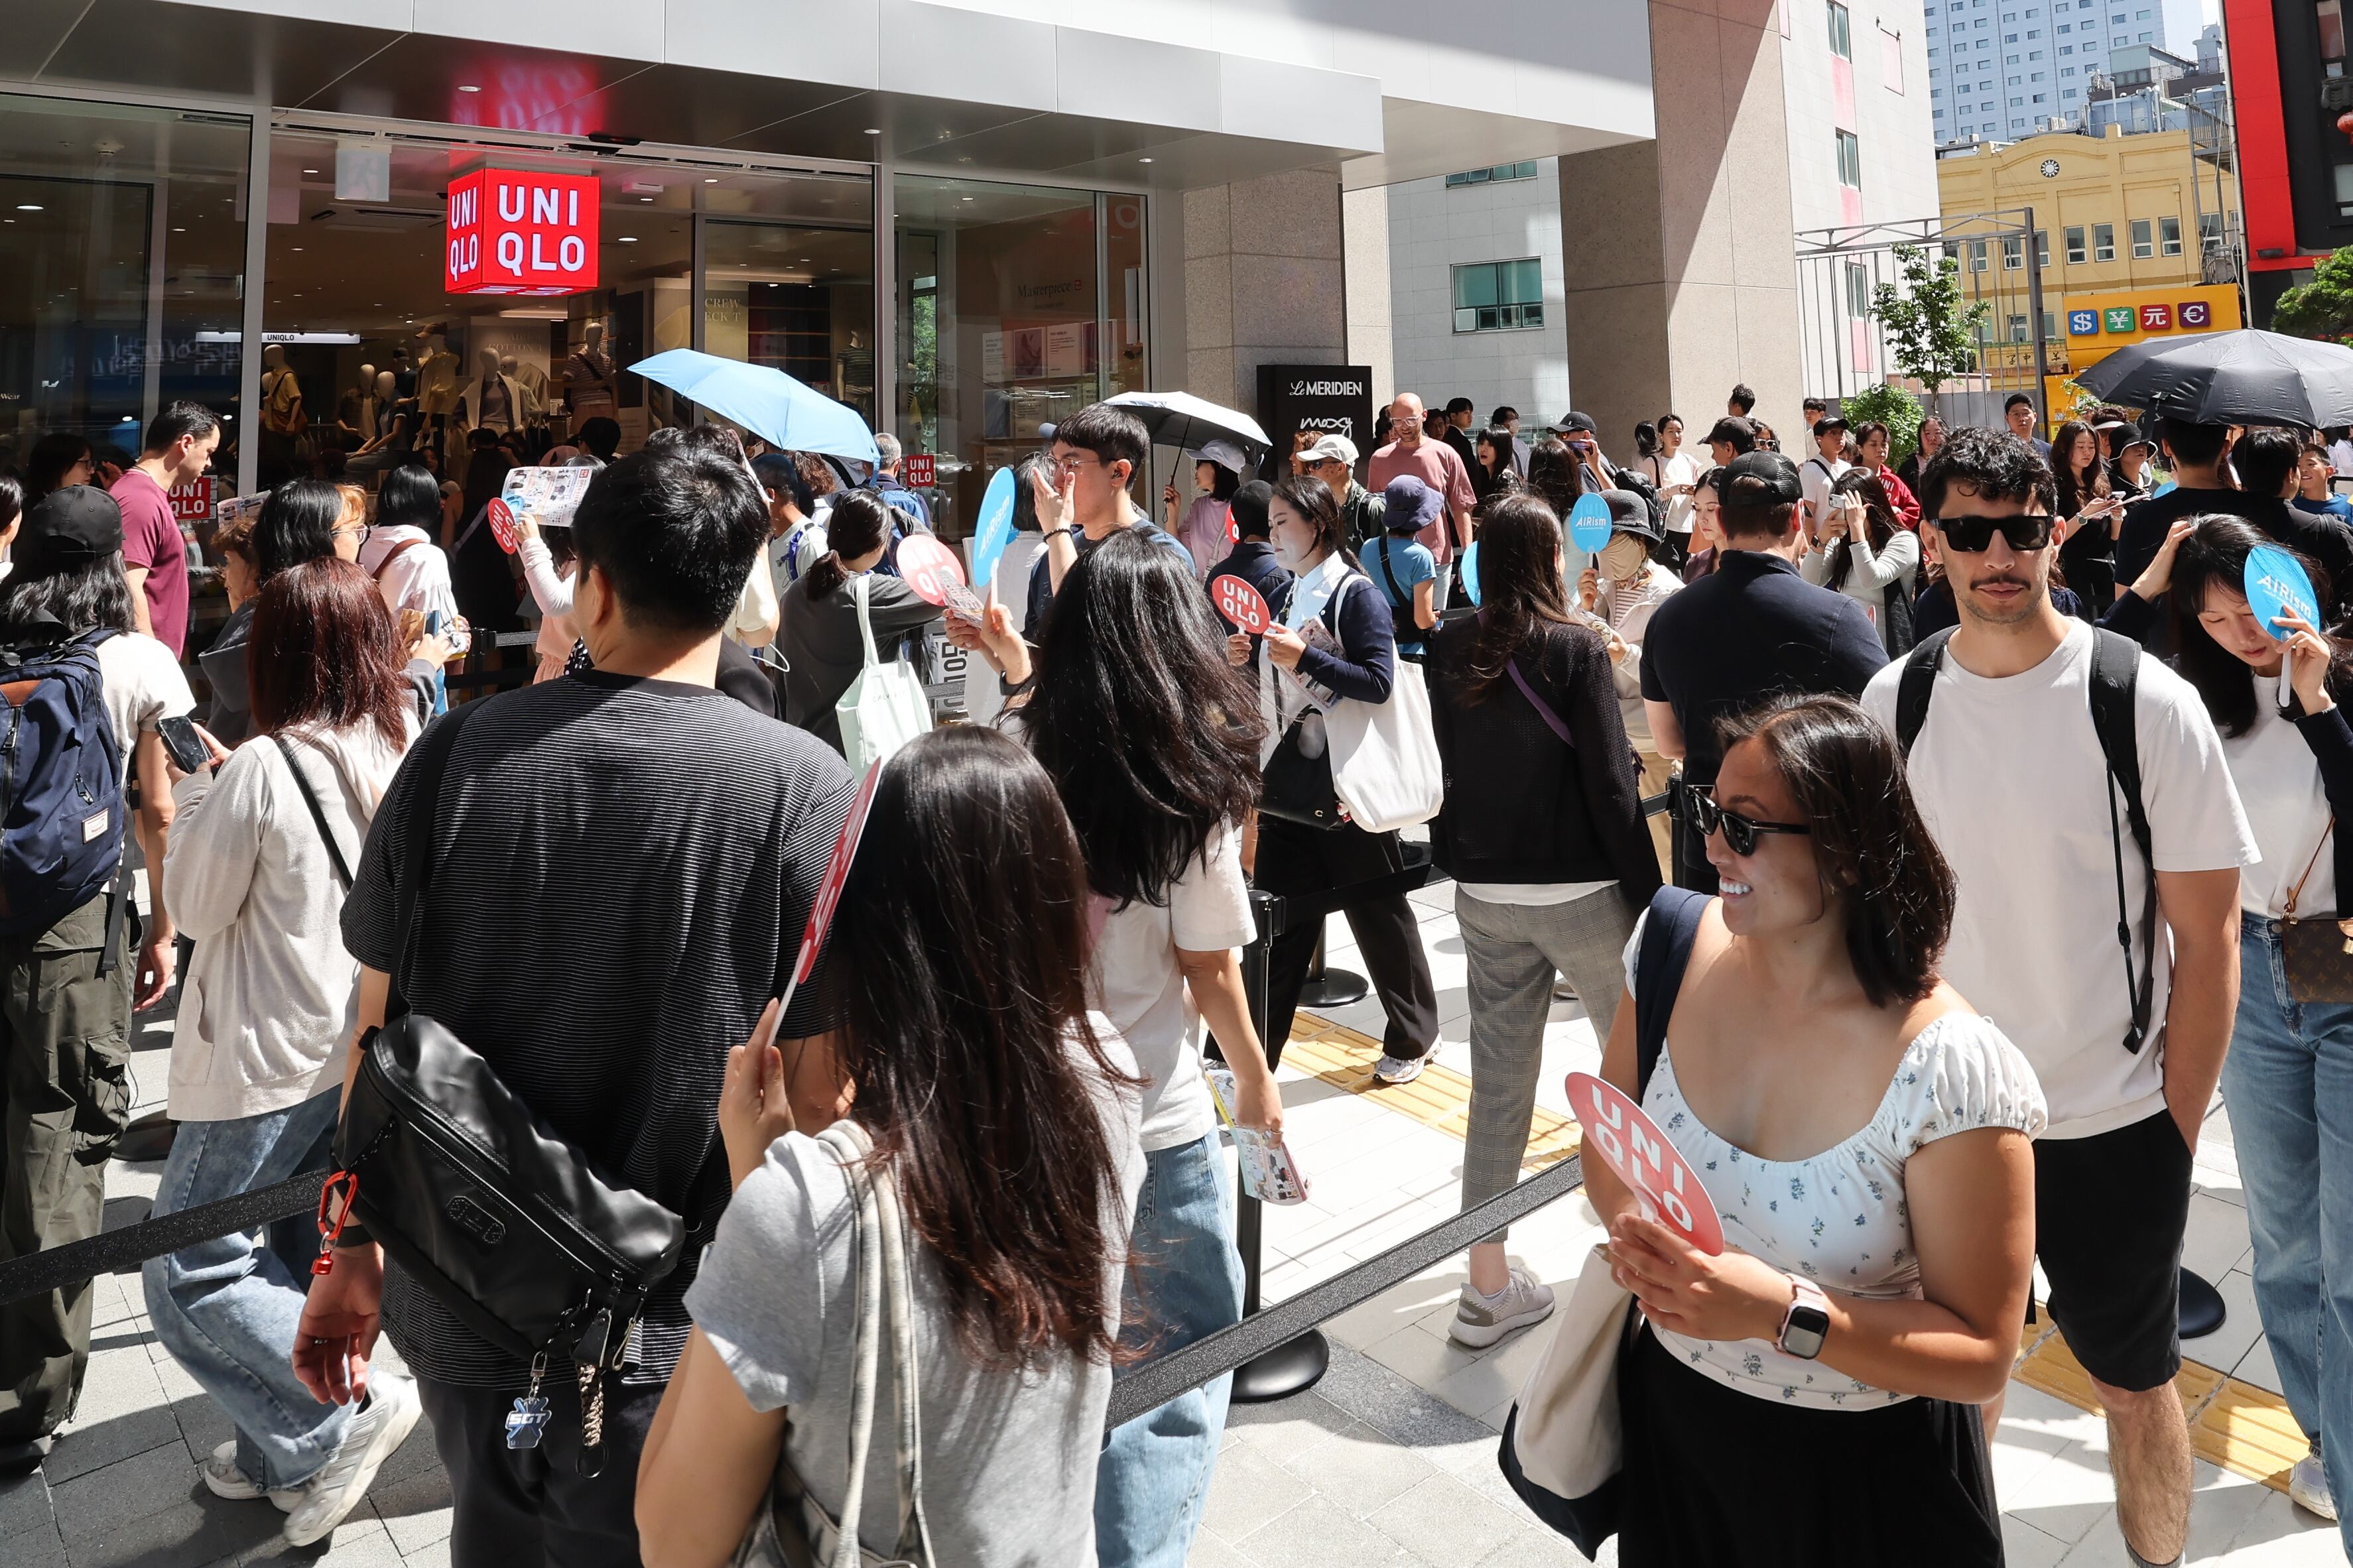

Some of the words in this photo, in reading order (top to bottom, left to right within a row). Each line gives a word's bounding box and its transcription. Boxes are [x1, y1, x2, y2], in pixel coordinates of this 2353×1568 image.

[451, 186, 477, 229] UNI
[499, 184, 578, 226] UNI
[450, 233, 477, 281] QLO
[497, 231, 584, 276] QLO
[705, 298, 740, 308] CREW
[1018, 281, 1072, 298] Masterpiece
[2073, 312, 2092, 332] $
[2108, 310, 2129, 329] ¥
[2144, 308, 2167, 326] 元
[2183, 305, 2204, 324] €
[1306, 381, 1362, 396] MERIDIEN
[910, 459, 930, 470] UNI
[910, 471, 932, 485] QLO
[169, 483, 202, 497] UNI
[169, 500, 204, 517] QLO
[492, 504, 505, 535] UNI
[1575, 516, 1606, 527] AIRism
[502, 515, 513, 548] QLO
[1223, 579, 1257, 610] UNI
[2256, 574, 2311, 619] AIRism
[1223, 597, 1260, 627] QLO
[1592, 1083, 1684, 1196] UNI
[1595, 1122, 1693, 1232] QLO
